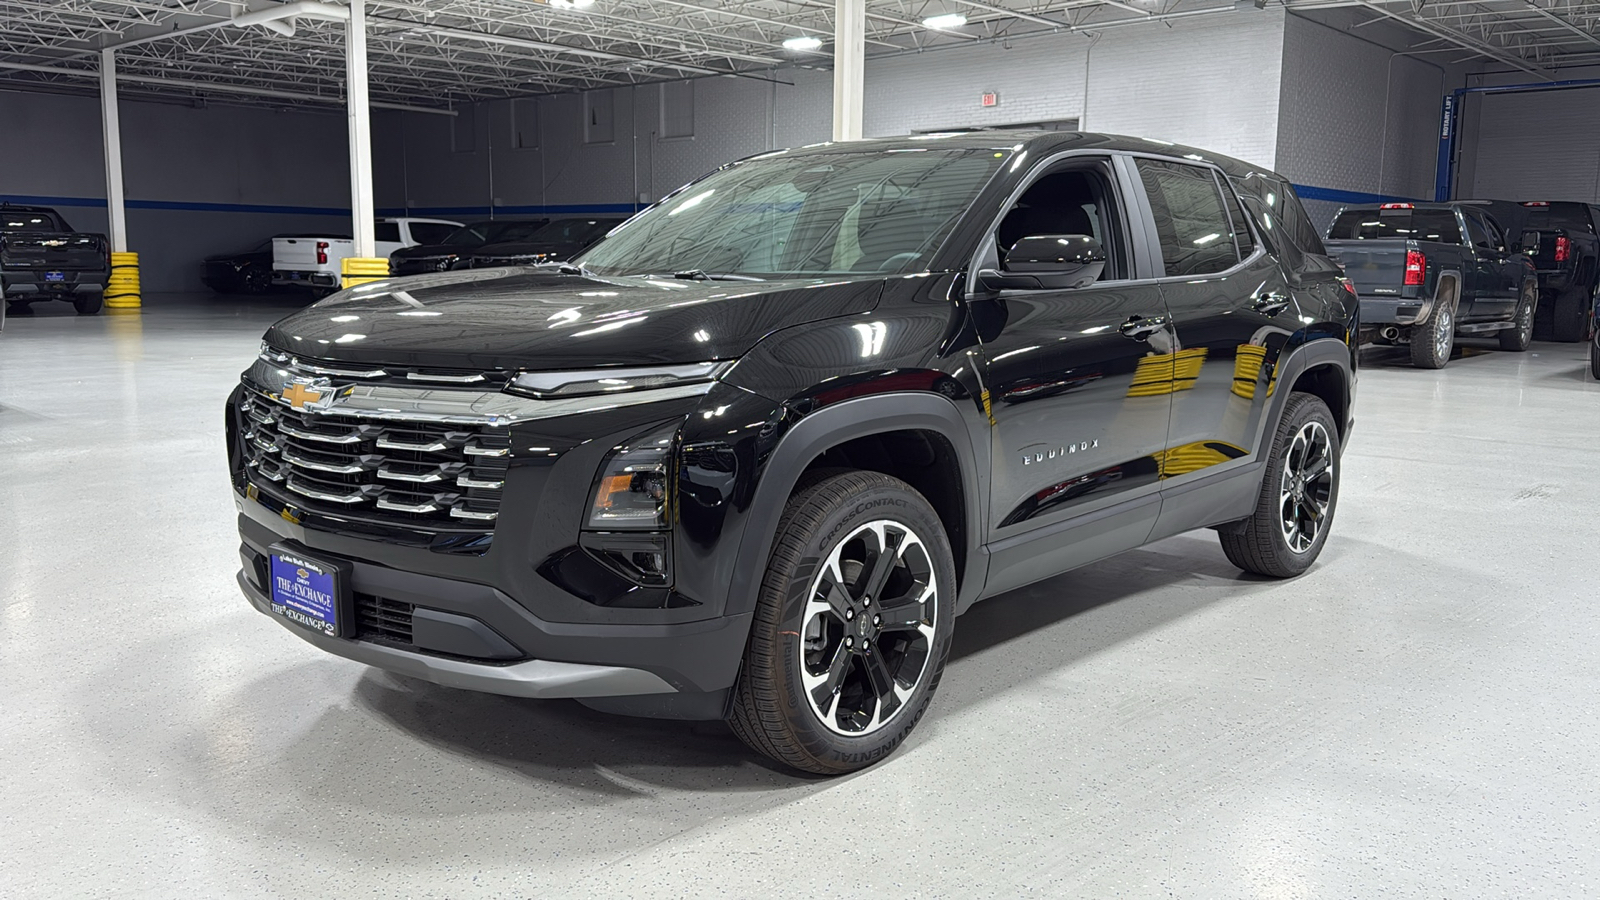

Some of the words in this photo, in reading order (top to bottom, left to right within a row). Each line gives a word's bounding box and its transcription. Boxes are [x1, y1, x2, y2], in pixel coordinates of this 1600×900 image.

[984, 94, 994, 105] EXIT
[1442, 110, 1451, 135] ROTARY
[1022, 438, 1099, 466] EQUINOX
[276, 577, 292, 591] THE
[294, 582, 332, 608] EXCHANGE
[296, 577, 310, 586] CHEVY
[271, 603, 284, 615] THE
[288, 609, 323, 630] EXCHANGE
[832, 696, 930, 764] CONTINENTAL
